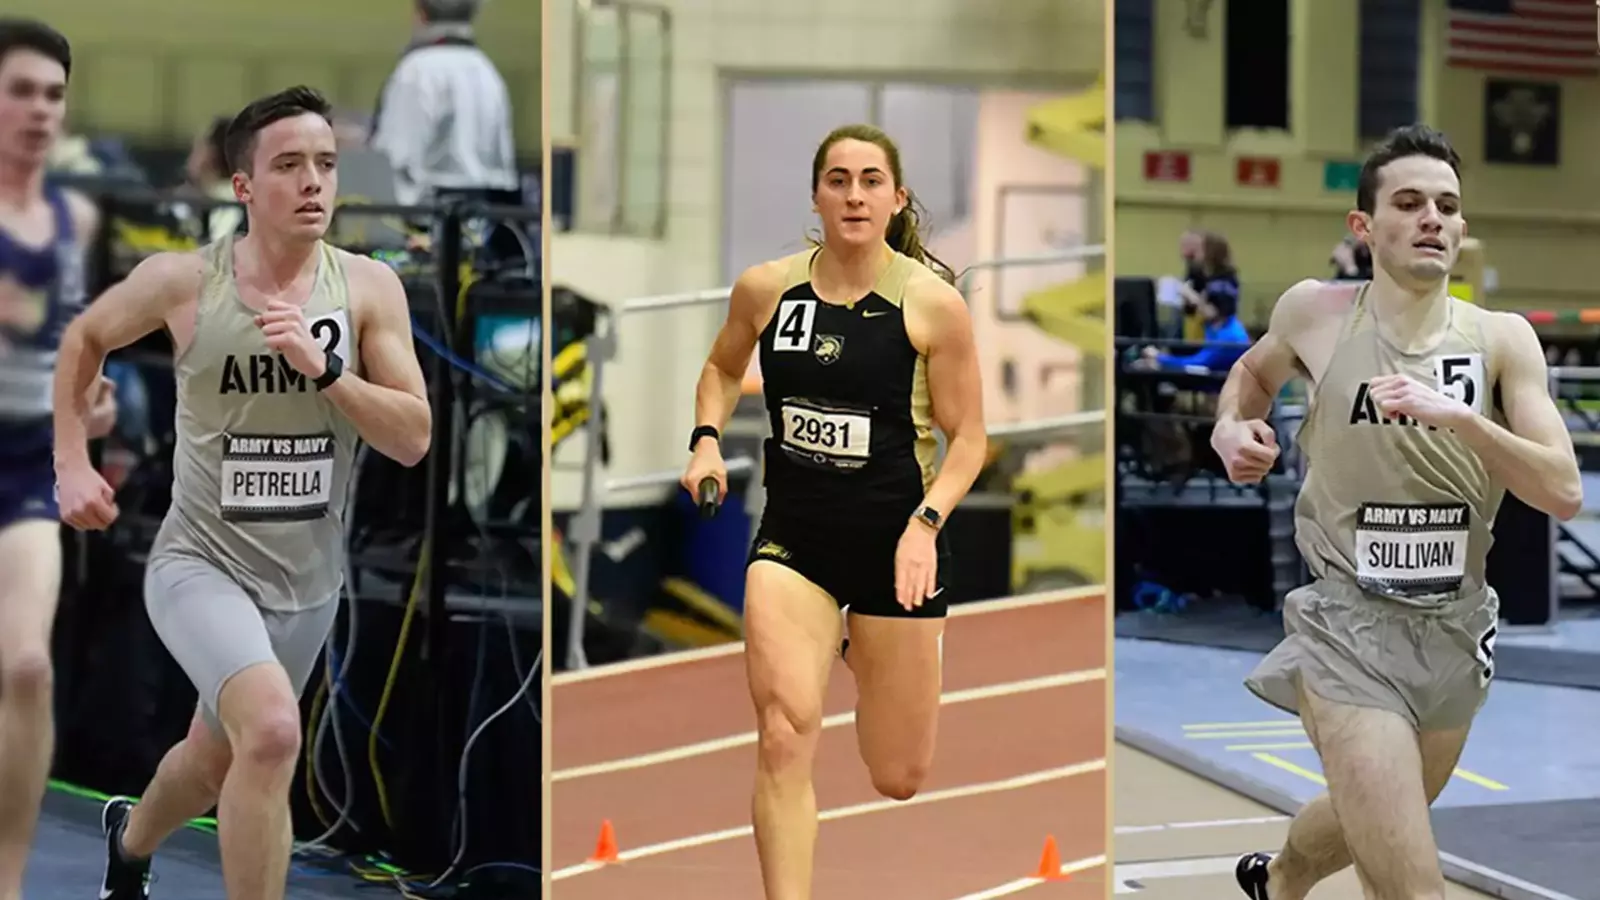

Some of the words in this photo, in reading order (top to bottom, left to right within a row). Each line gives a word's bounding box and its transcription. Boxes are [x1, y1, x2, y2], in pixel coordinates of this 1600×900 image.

[779, 303, 807, 347] 4
[219, 353, 322, 394] ARM
[1442, 358, 1475, 406] 5
[229, 437, 271, 454] ARMY
[272, 438, 292, 455] VS
[294, 437, 329, 455] NAVY
[792, 414, 849, 449] 2931
[233, 470, 321, 497] PETRELLA
[1363, 507, 1406, 525] ARMY
[1408, 508, 1427, 525] VS
[1428, 507, 1464, 524] NAVY
[1368, 540, 1455, 569] SULLIVAN
